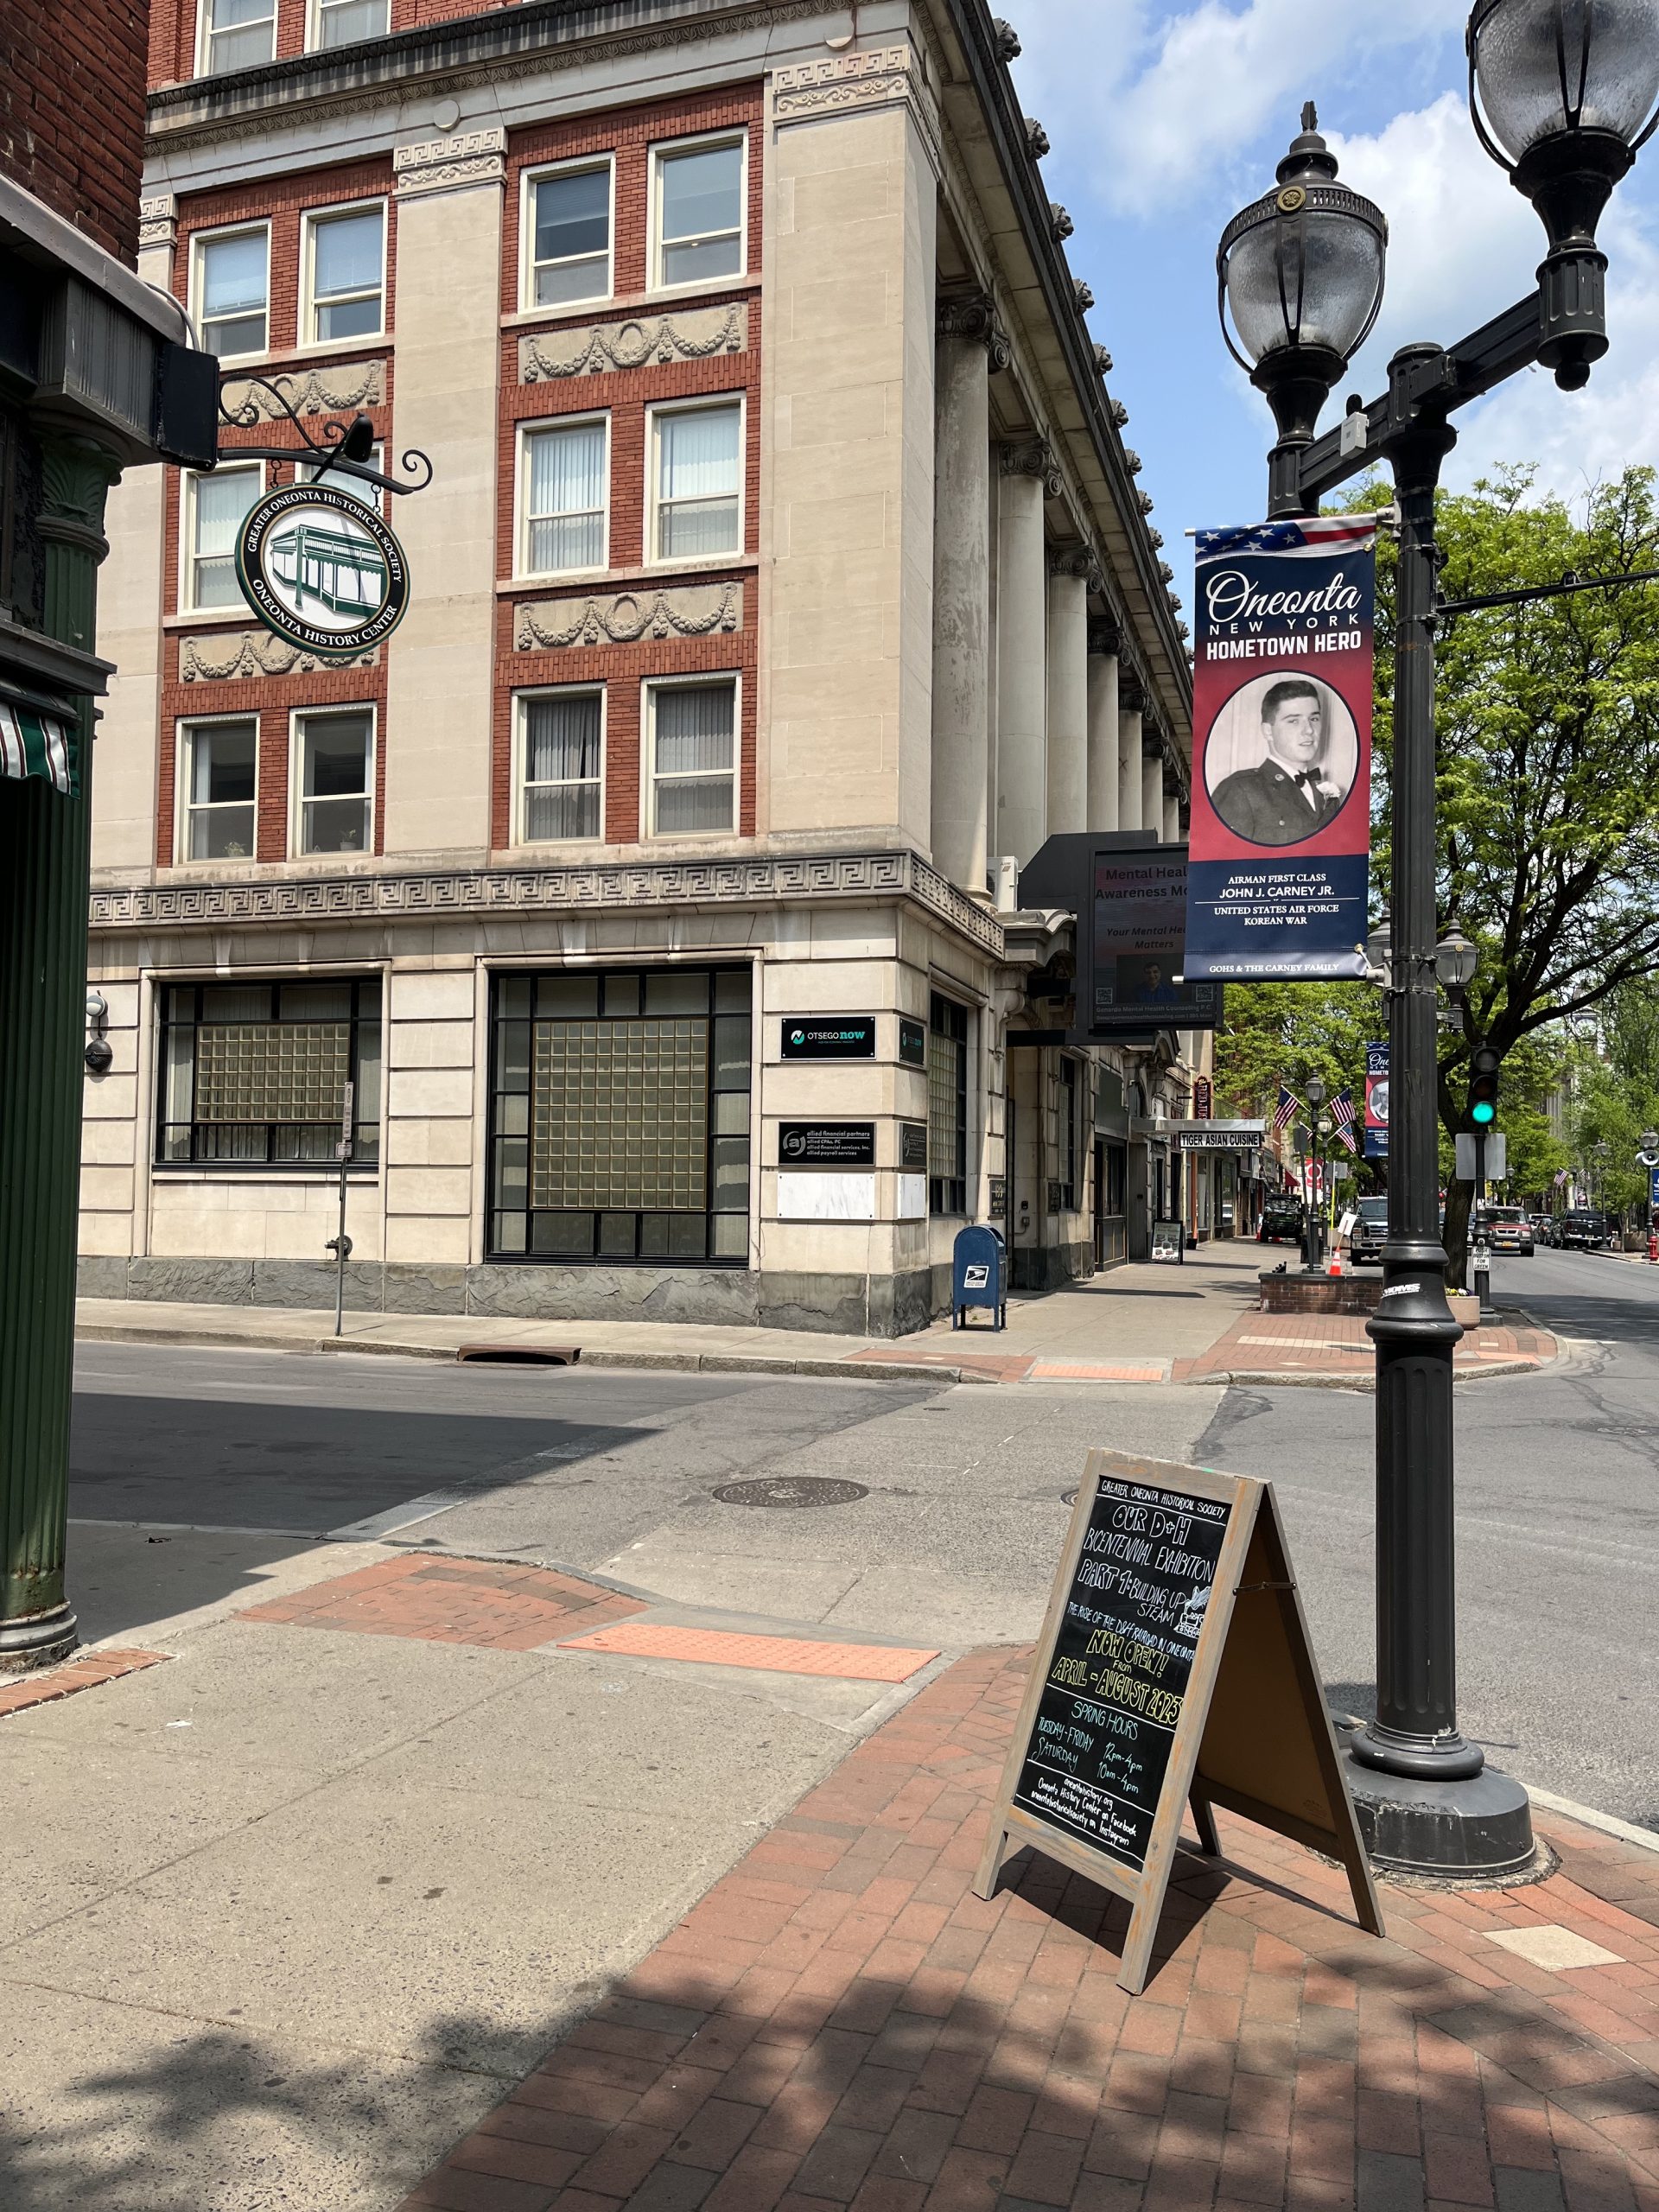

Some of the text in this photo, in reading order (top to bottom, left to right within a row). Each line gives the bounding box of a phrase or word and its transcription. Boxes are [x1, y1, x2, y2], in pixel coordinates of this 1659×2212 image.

[247, 491, 402, 582] GREATER ONEONTA HISTORICAL SOCIETY
[1206, 570, 1362, 623] Oneonta
[252, 579, 397, 646] ONEONTA HISTORY CENTER
[1209, 613, 1359, 636] NEW YORK
[1206, 630, 1361, 661] HOMETOWN HERO
[1106, 866, 1188, 880] Mental Heal
[1228, 873, 1326, 885] AIRMAN FIRST CLASS
[1096, 887, 1166, 899] Awareness
[1218, 886, 1335, 899] JOHN J. CARNEY JR.
[1214, 904, 1339, 916] UNITED STATES AIR FORCE
[1243, 916, 1307, 926] KOREAN WAR
[1107, 928, 1129, 938] Your
[1265, 963, 1302, 972] CARNEY
[1181, 1134, 1257, 1146] TIGER ASIAN CUISINE
[1102, 1479, 1226, 1519] GREATER ONEONTA HISTORICAL SOCIETY
[1112, 1504, 1148, 1532] OUR
[1083, 1528, 1216, 1582] BICENTENNIAL EXHIBITION
[1077, 1558, 1120, 1590] PART
[1129, 1577, 1169, 1608] BUILDING
[1169, 1592, 1186, 1610] UP
[1066, 1601, 1077, 1617] THE
[1077, 1605, 1092, 1622] RISE
[1091, 1611, 1103, 1624] OF
[1101, 1613, 1116, 1630] THE
[1137, 1603, 1175, 1627] STEAM
[1086, 1629, 1125, 1658] NOW
[1112, 1659, 1132, 1675] FROM
[1052, 1656, 1088, 1687] APRIL
[1146, 1688, 1184, 1725] 2023
[1071, 1701, 1139, 1741] SPRING HOURS
[1059, 1787, 1080, 1810] History
[1082, 1797, 1102, 1816] Center
[1102, 1812, 1109, 1821] on
[1110, 1812, 1137, 1837] Facebook
[1099, 1820, 1130, 1847] Instagram
